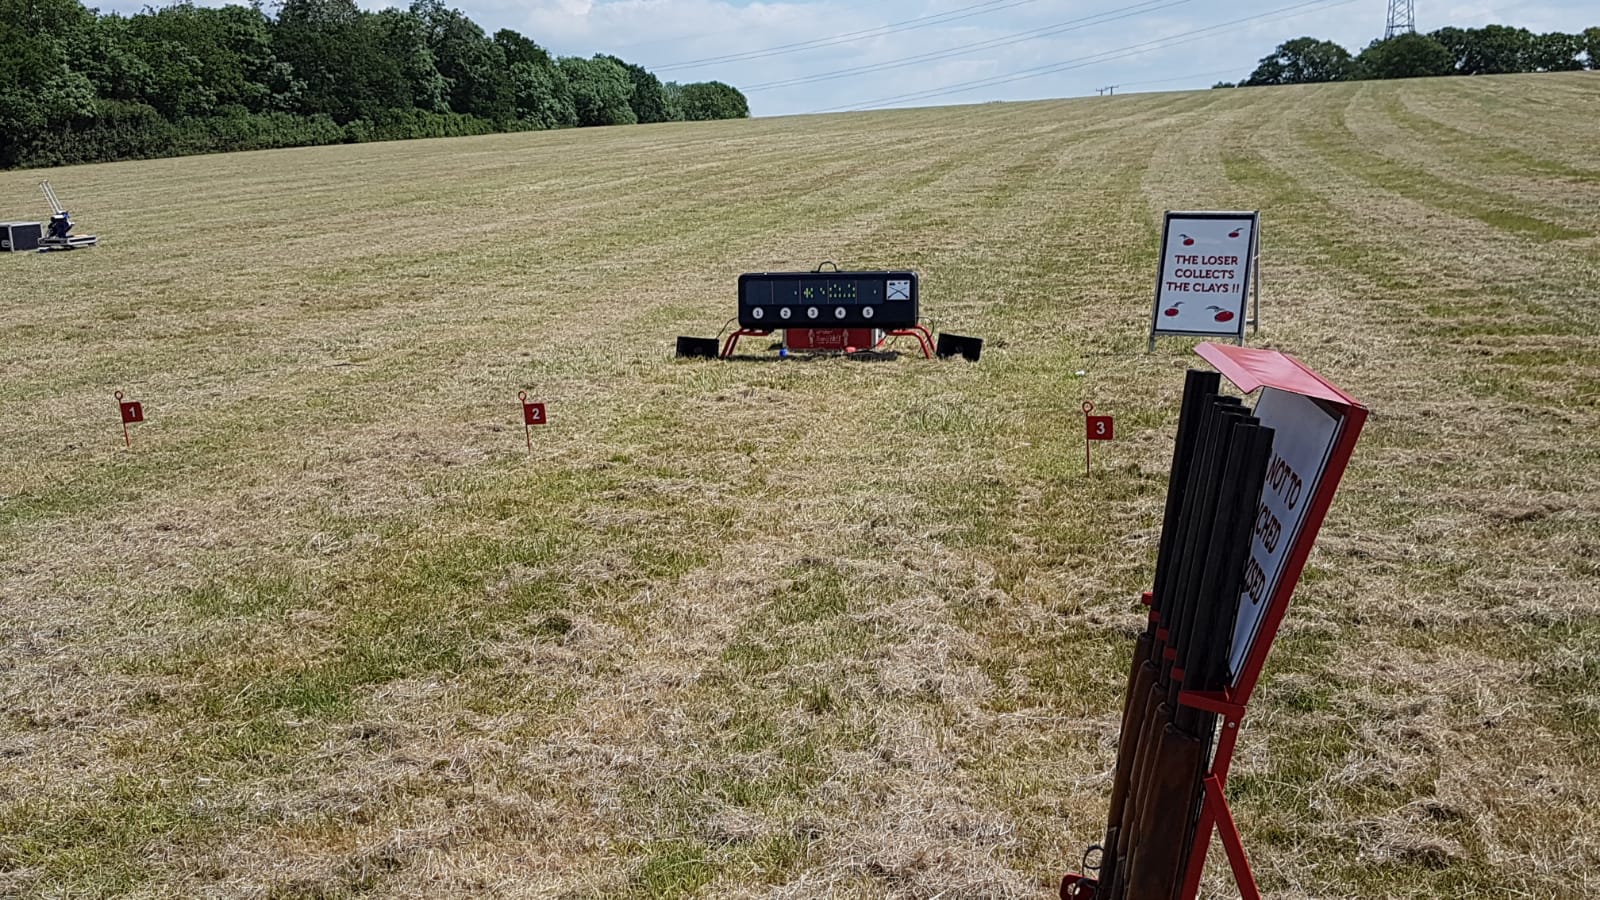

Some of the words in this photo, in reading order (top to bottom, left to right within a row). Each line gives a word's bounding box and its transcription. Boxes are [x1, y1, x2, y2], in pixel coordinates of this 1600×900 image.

[1174, 255, 1199, 265] THE
[1201, 255, 1238, 266] LOSER
[1174, 268, 1235, 279] COLLECTS
[1166, 281, 1190, 292] THE
[1192, 282, 1229, 293] CLAYS
[1232, 283, 1240, 293] !!
[128, 406, 136, 418] 1
[532, 407, 541, 420] 2
[1096, 420, 1106, 435] 3
[1265, 452, 1291, 497] NOT
[1284, 470, 1303, 511] TO
